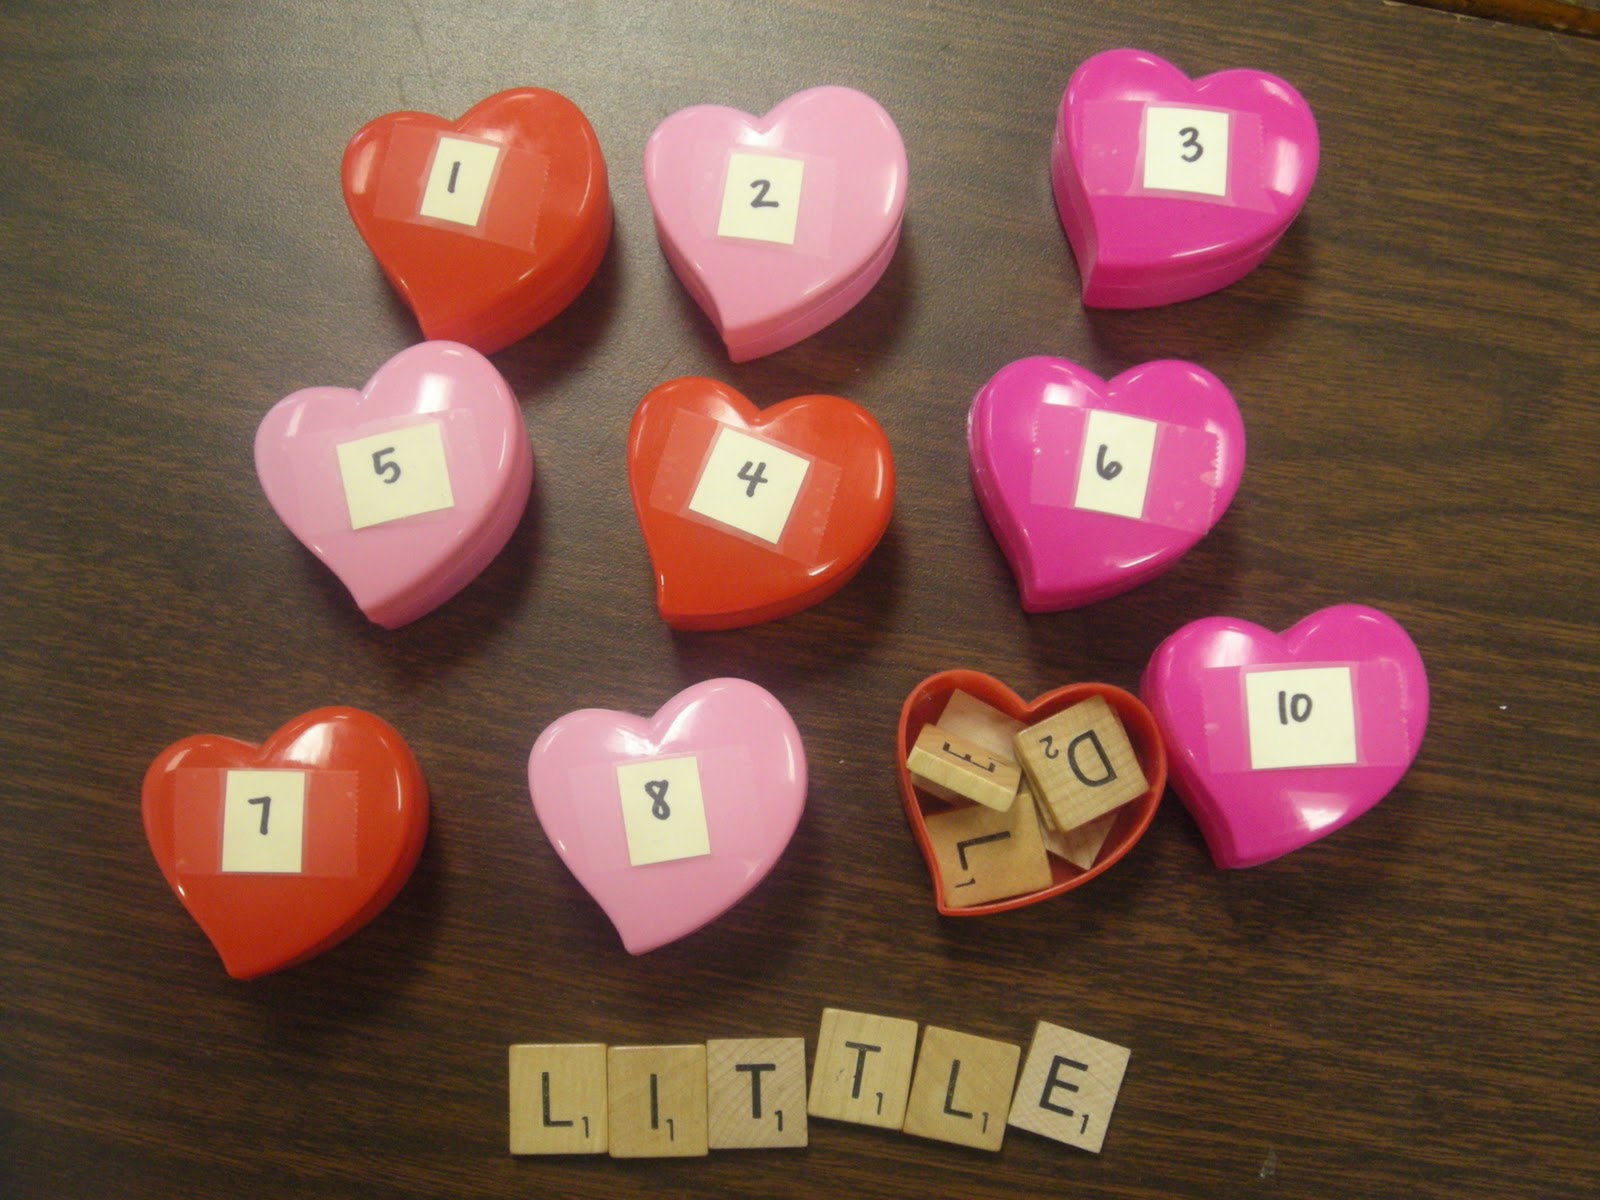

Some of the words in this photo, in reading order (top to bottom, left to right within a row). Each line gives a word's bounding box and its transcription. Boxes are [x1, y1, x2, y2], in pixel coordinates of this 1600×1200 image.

[1178, 126, 1204, 163] 3
[447, 160, 461, 194] 1
[749, 179, 780, 209] 2
[371, 446, 402, 485] 5
[736, 460, 769, 498] 4
[1095, 443, 1123, 481] 6
[1277, 690, 1313, 726] 10
[1038, 735, 1060, 760] 2
[1066, 728, 1118, 788] D
[247, 795, 272, 836] 7
[644, 779, 671, 821] 8
[956, 830, 1011, 871] L
[774, 1109, 784, 1132] 1
[875, 1091, 884, 1116] 1
[581, 1115, 590, 1139] 1
[665, 1118, 674, 1142] 1
[981, 1111, 990, 1135] 1
[1080, 1113, 1090, 1135] 1
